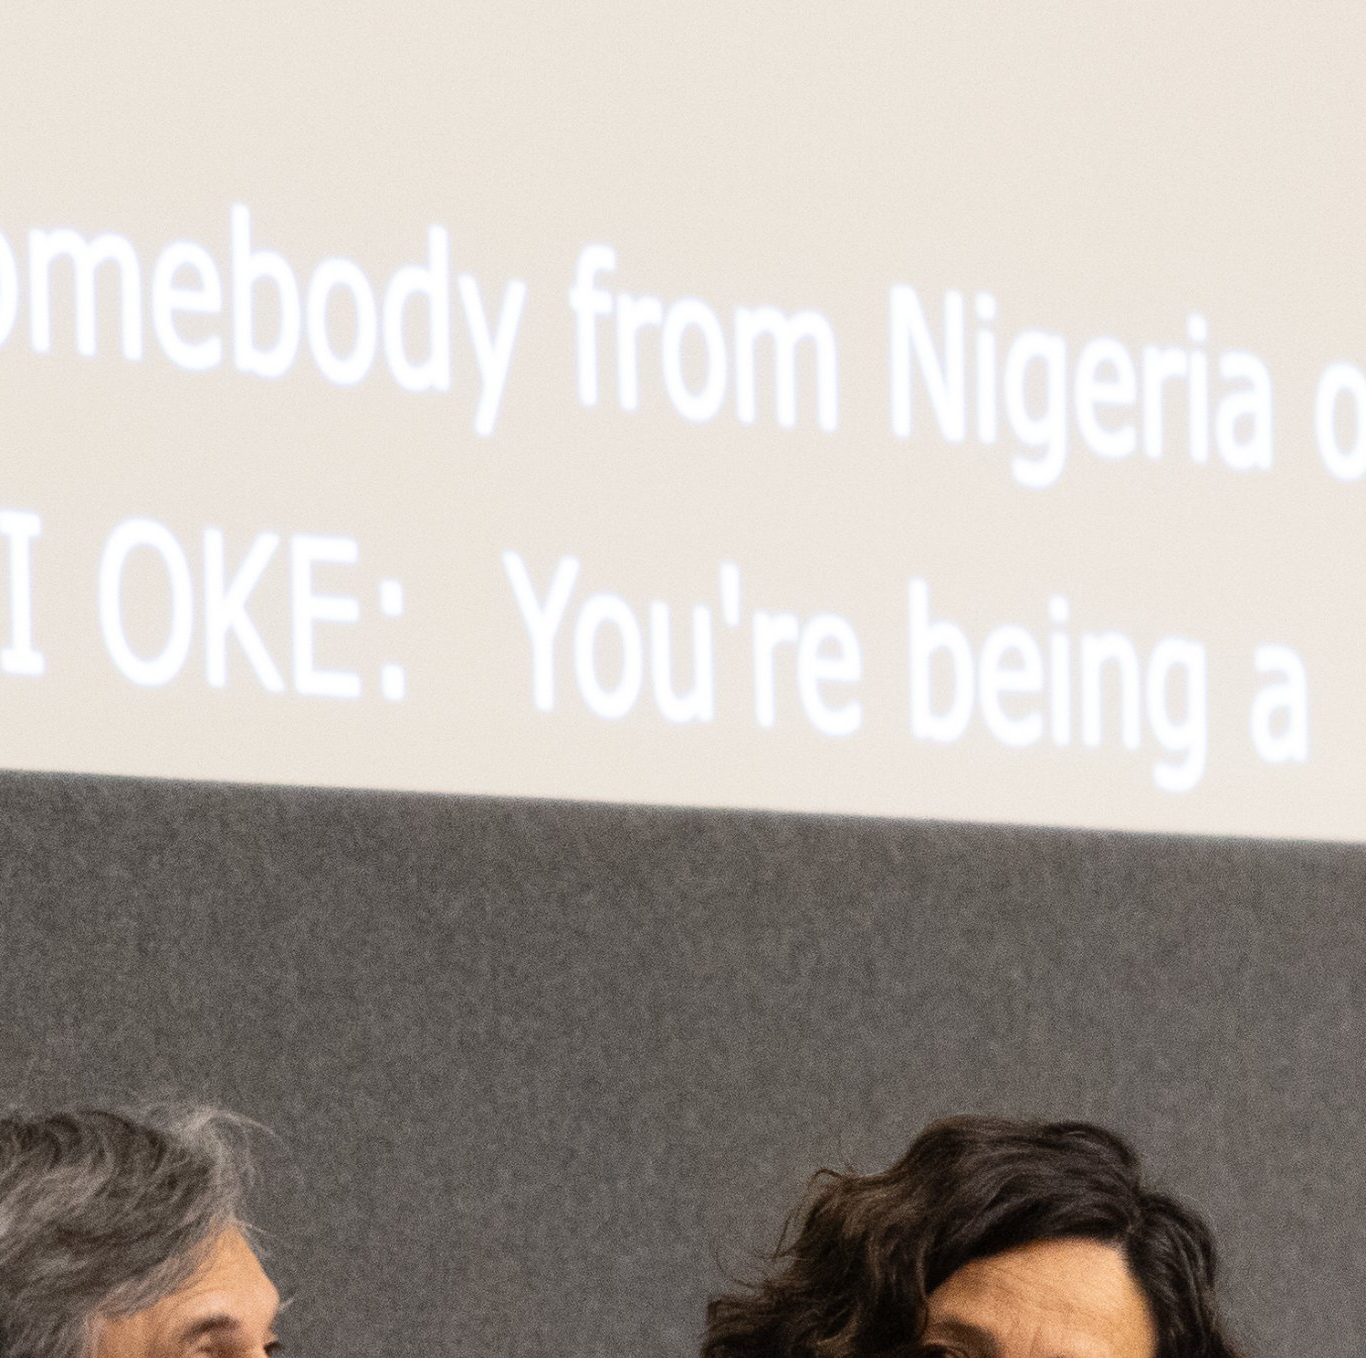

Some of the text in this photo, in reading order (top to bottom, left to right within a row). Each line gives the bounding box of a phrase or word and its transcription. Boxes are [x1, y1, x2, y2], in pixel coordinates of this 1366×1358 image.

[567, 241, 841, 435] from
[887, 282, 1276, 492] Nigeria
[96, 514, 408, 704] OKE:
[501, 549, 865, 740] You're
[906, 576, 1210, 795] being
[1248, 642, 1311, 766] a
